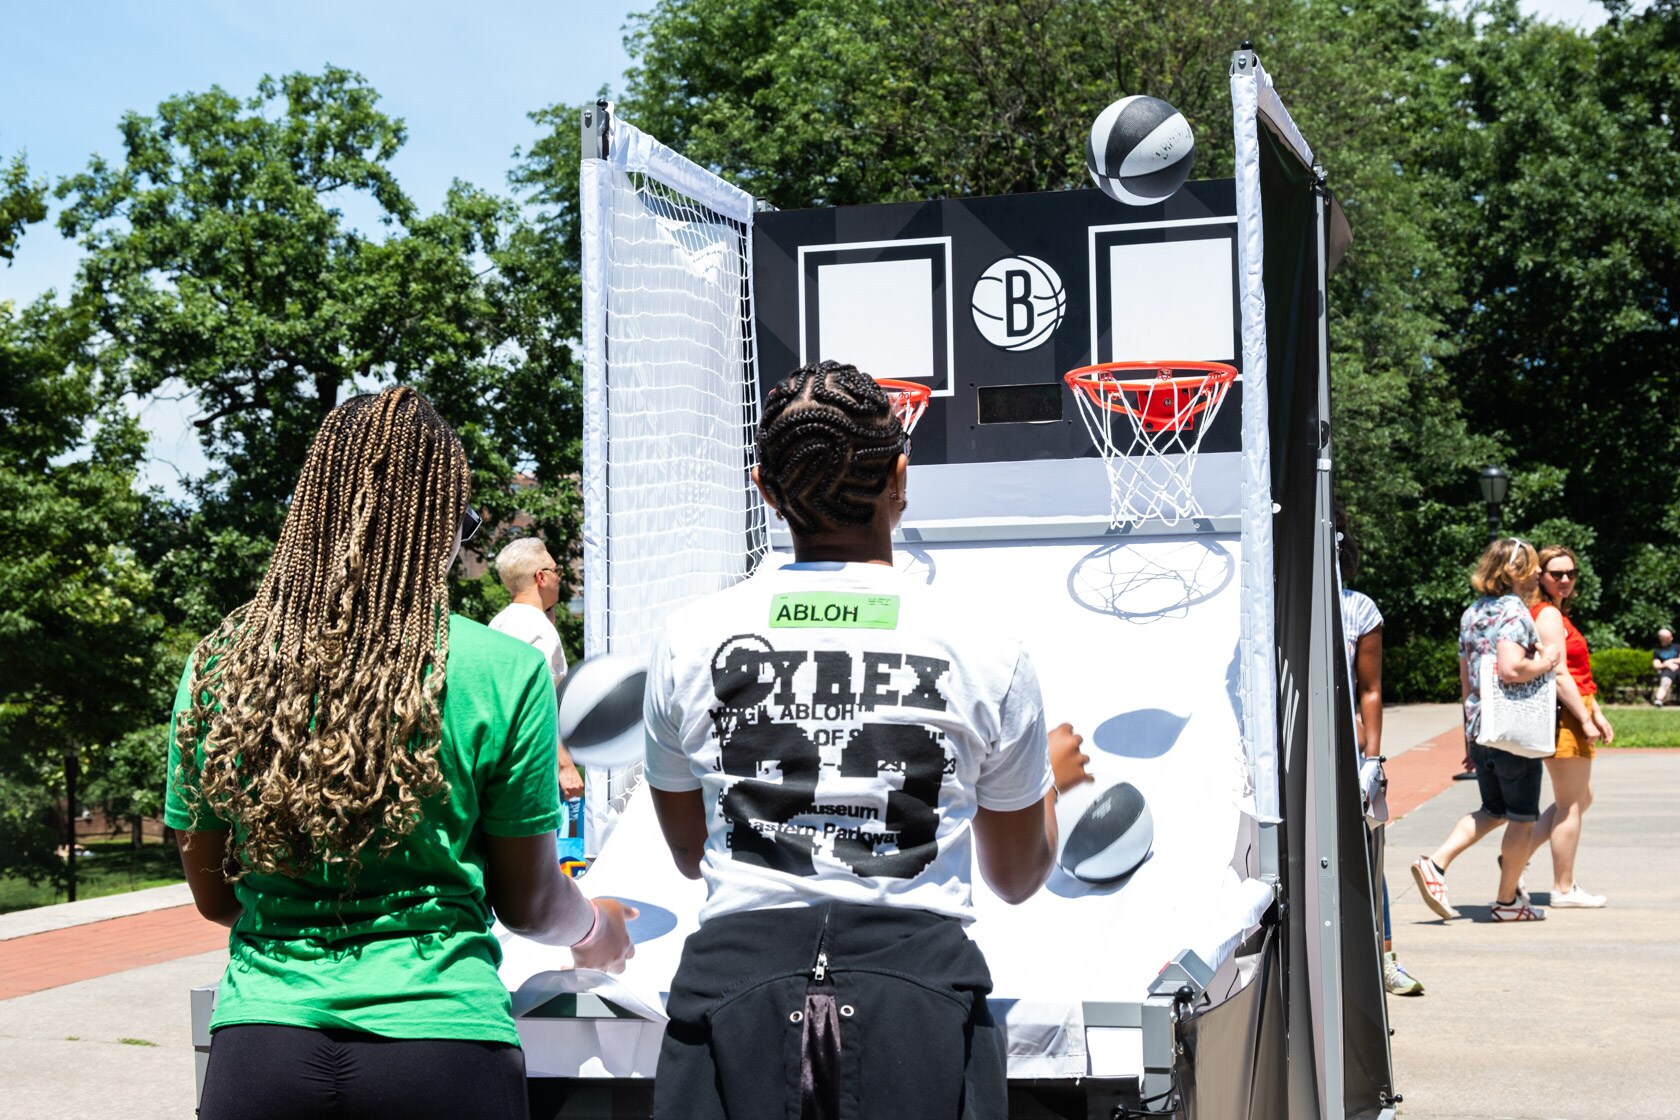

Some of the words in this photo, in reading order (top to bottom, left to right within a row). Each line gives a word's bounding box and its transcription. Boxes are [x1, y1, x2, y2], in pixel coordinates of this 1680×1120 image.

[1005, 269, 1035, 338] B
[776, 603, 859, 622] ABLOH
[813, 729, 844, 747] OF
